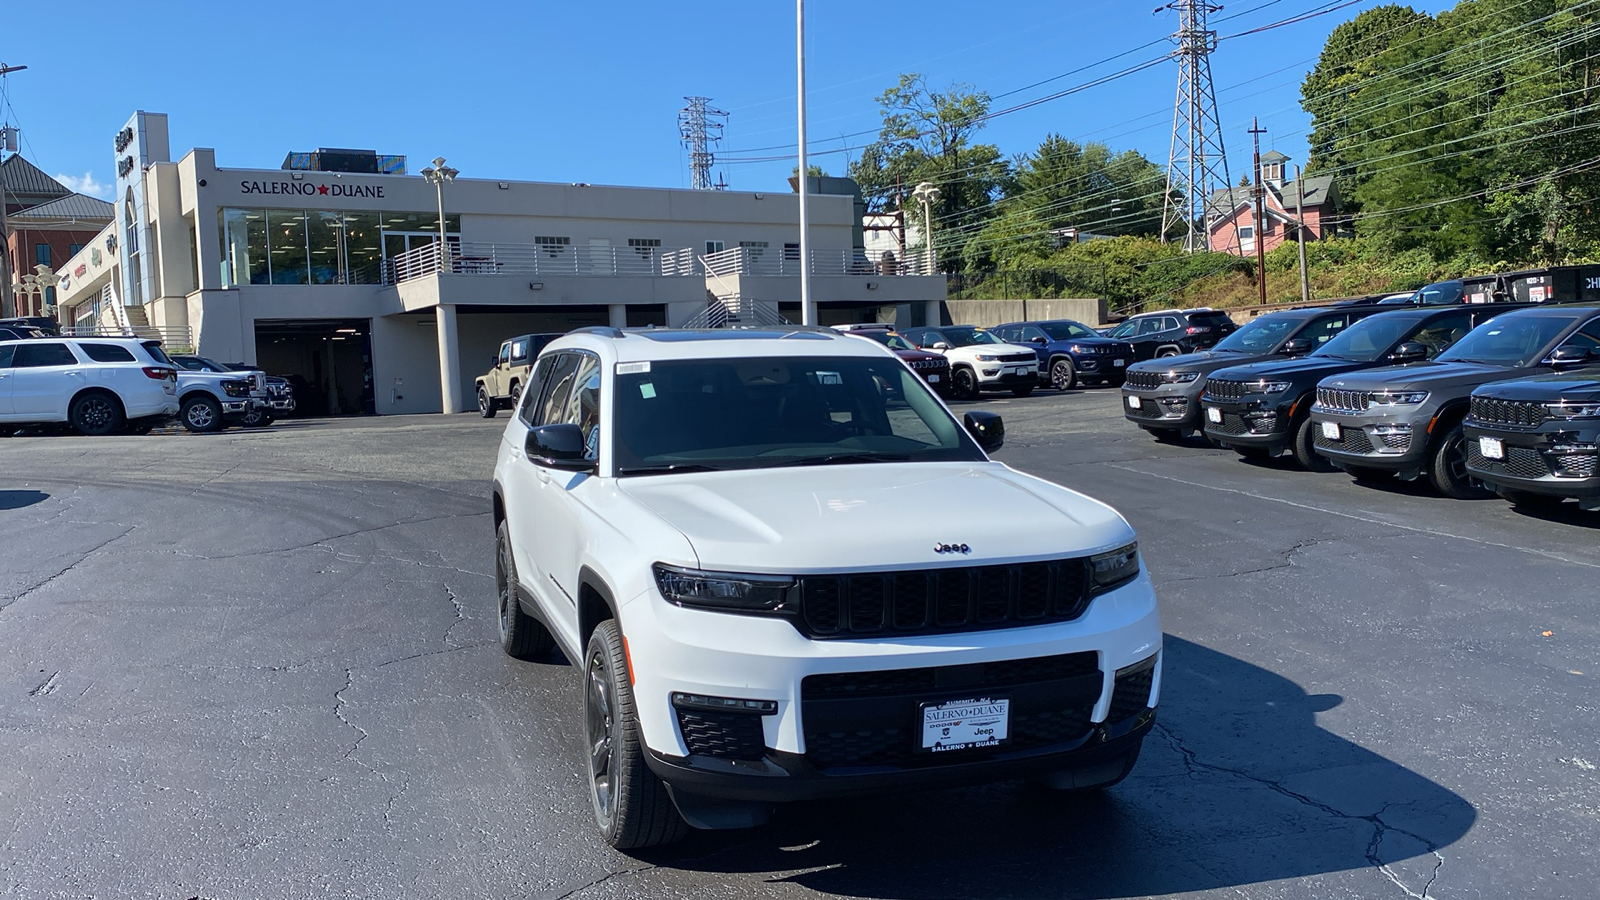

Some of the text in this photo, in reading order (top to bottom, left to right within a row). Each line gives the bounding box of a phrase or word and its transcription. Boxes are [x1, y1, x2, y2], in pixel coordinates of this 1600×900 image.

[241, 181, 385, 198] SALERNO DUANE
[934, 542, 969, 554] Jeep
[926, 709, 968, 721] SALERNO
[973, 705, 1005, 716] DUANE
[974, 728, 994, 736] Jeep
[931, 740, 1000, 752] SALERNO DUANE
